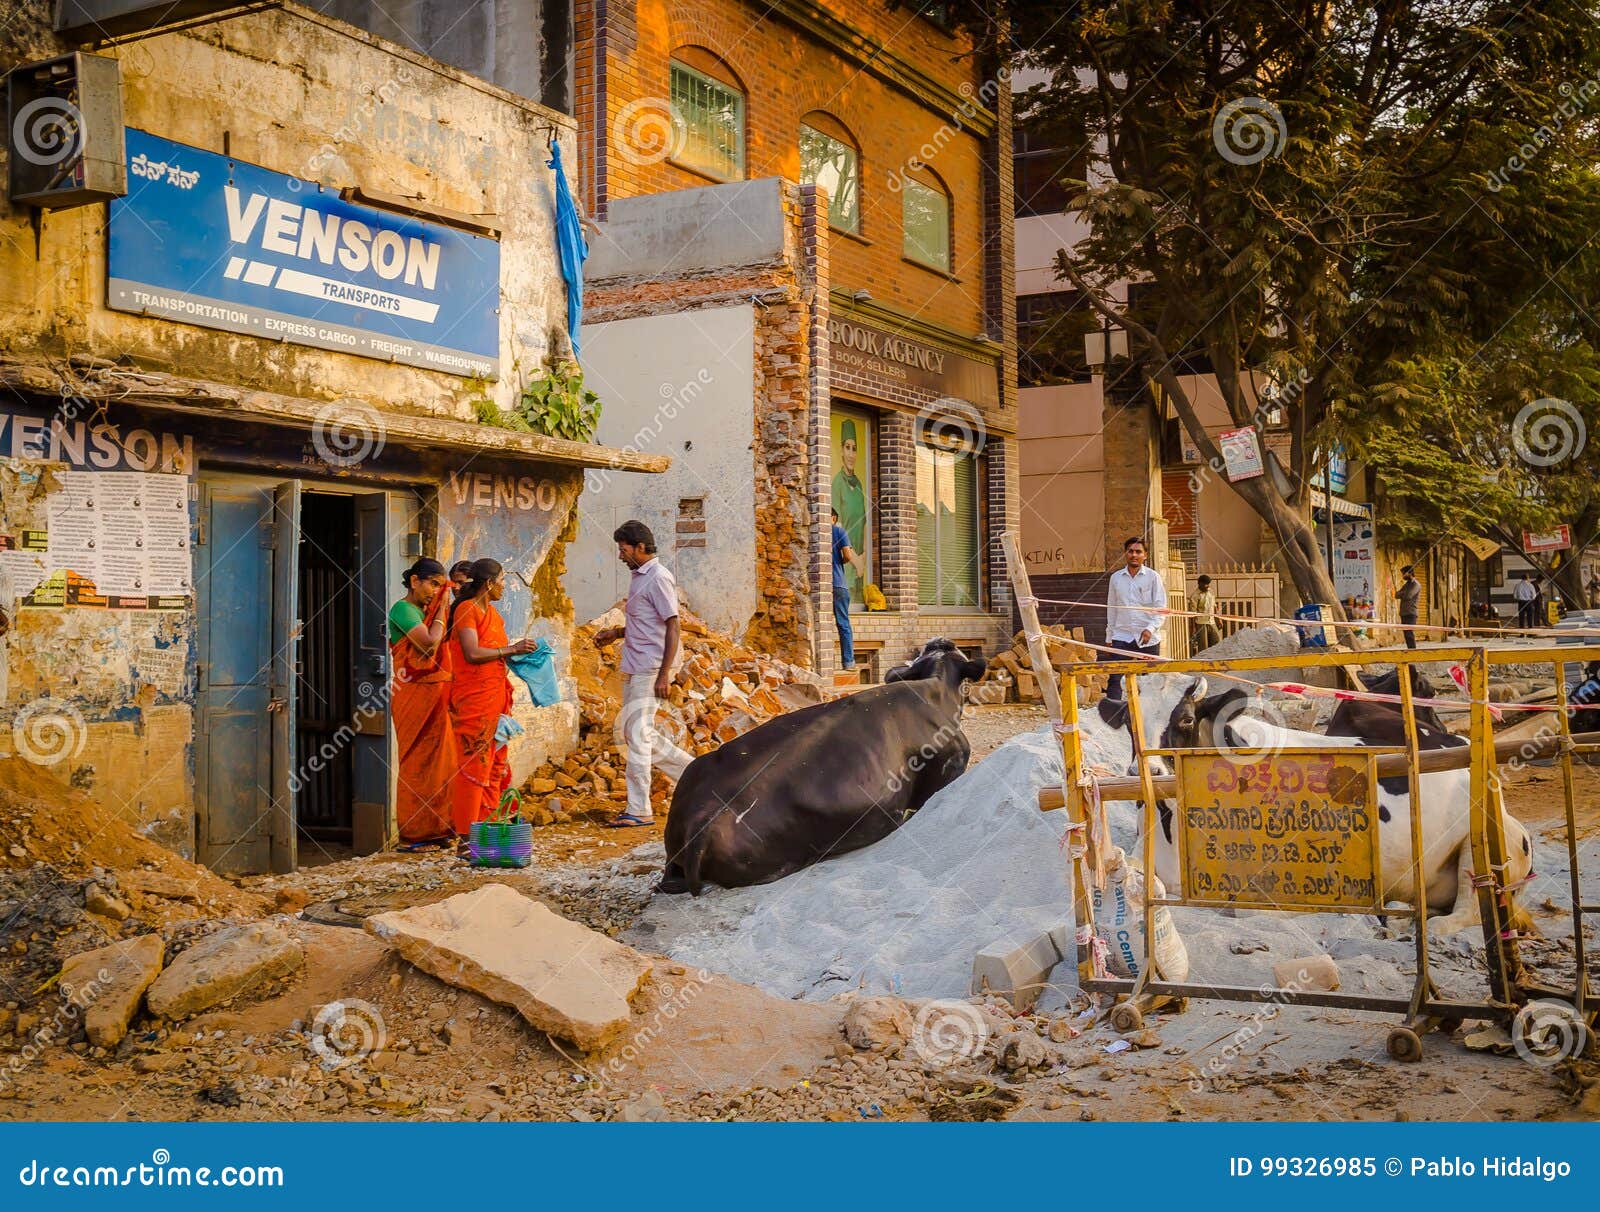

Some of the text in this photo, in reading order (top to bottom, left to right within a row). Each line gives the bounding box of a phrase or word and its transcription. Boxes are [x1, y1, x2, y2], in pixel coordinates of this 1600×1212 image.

[224, 185, 441, 291] VENSON
[322, 282, 401, 311] TRANSPORTS
[132, 291, 492, 373] TRANSPORTATION EXPRESS CARGO FREIGHT WAREHOUSING
[828, 319, 945, 375] BOOK AGENCY
[836, 350, 907, 379] BOOK SELLERS
[450, 470, 561, 512] VENSO
[1024, 547, 1065, 564] KING
[1112, 881, 1127, 927] almia
